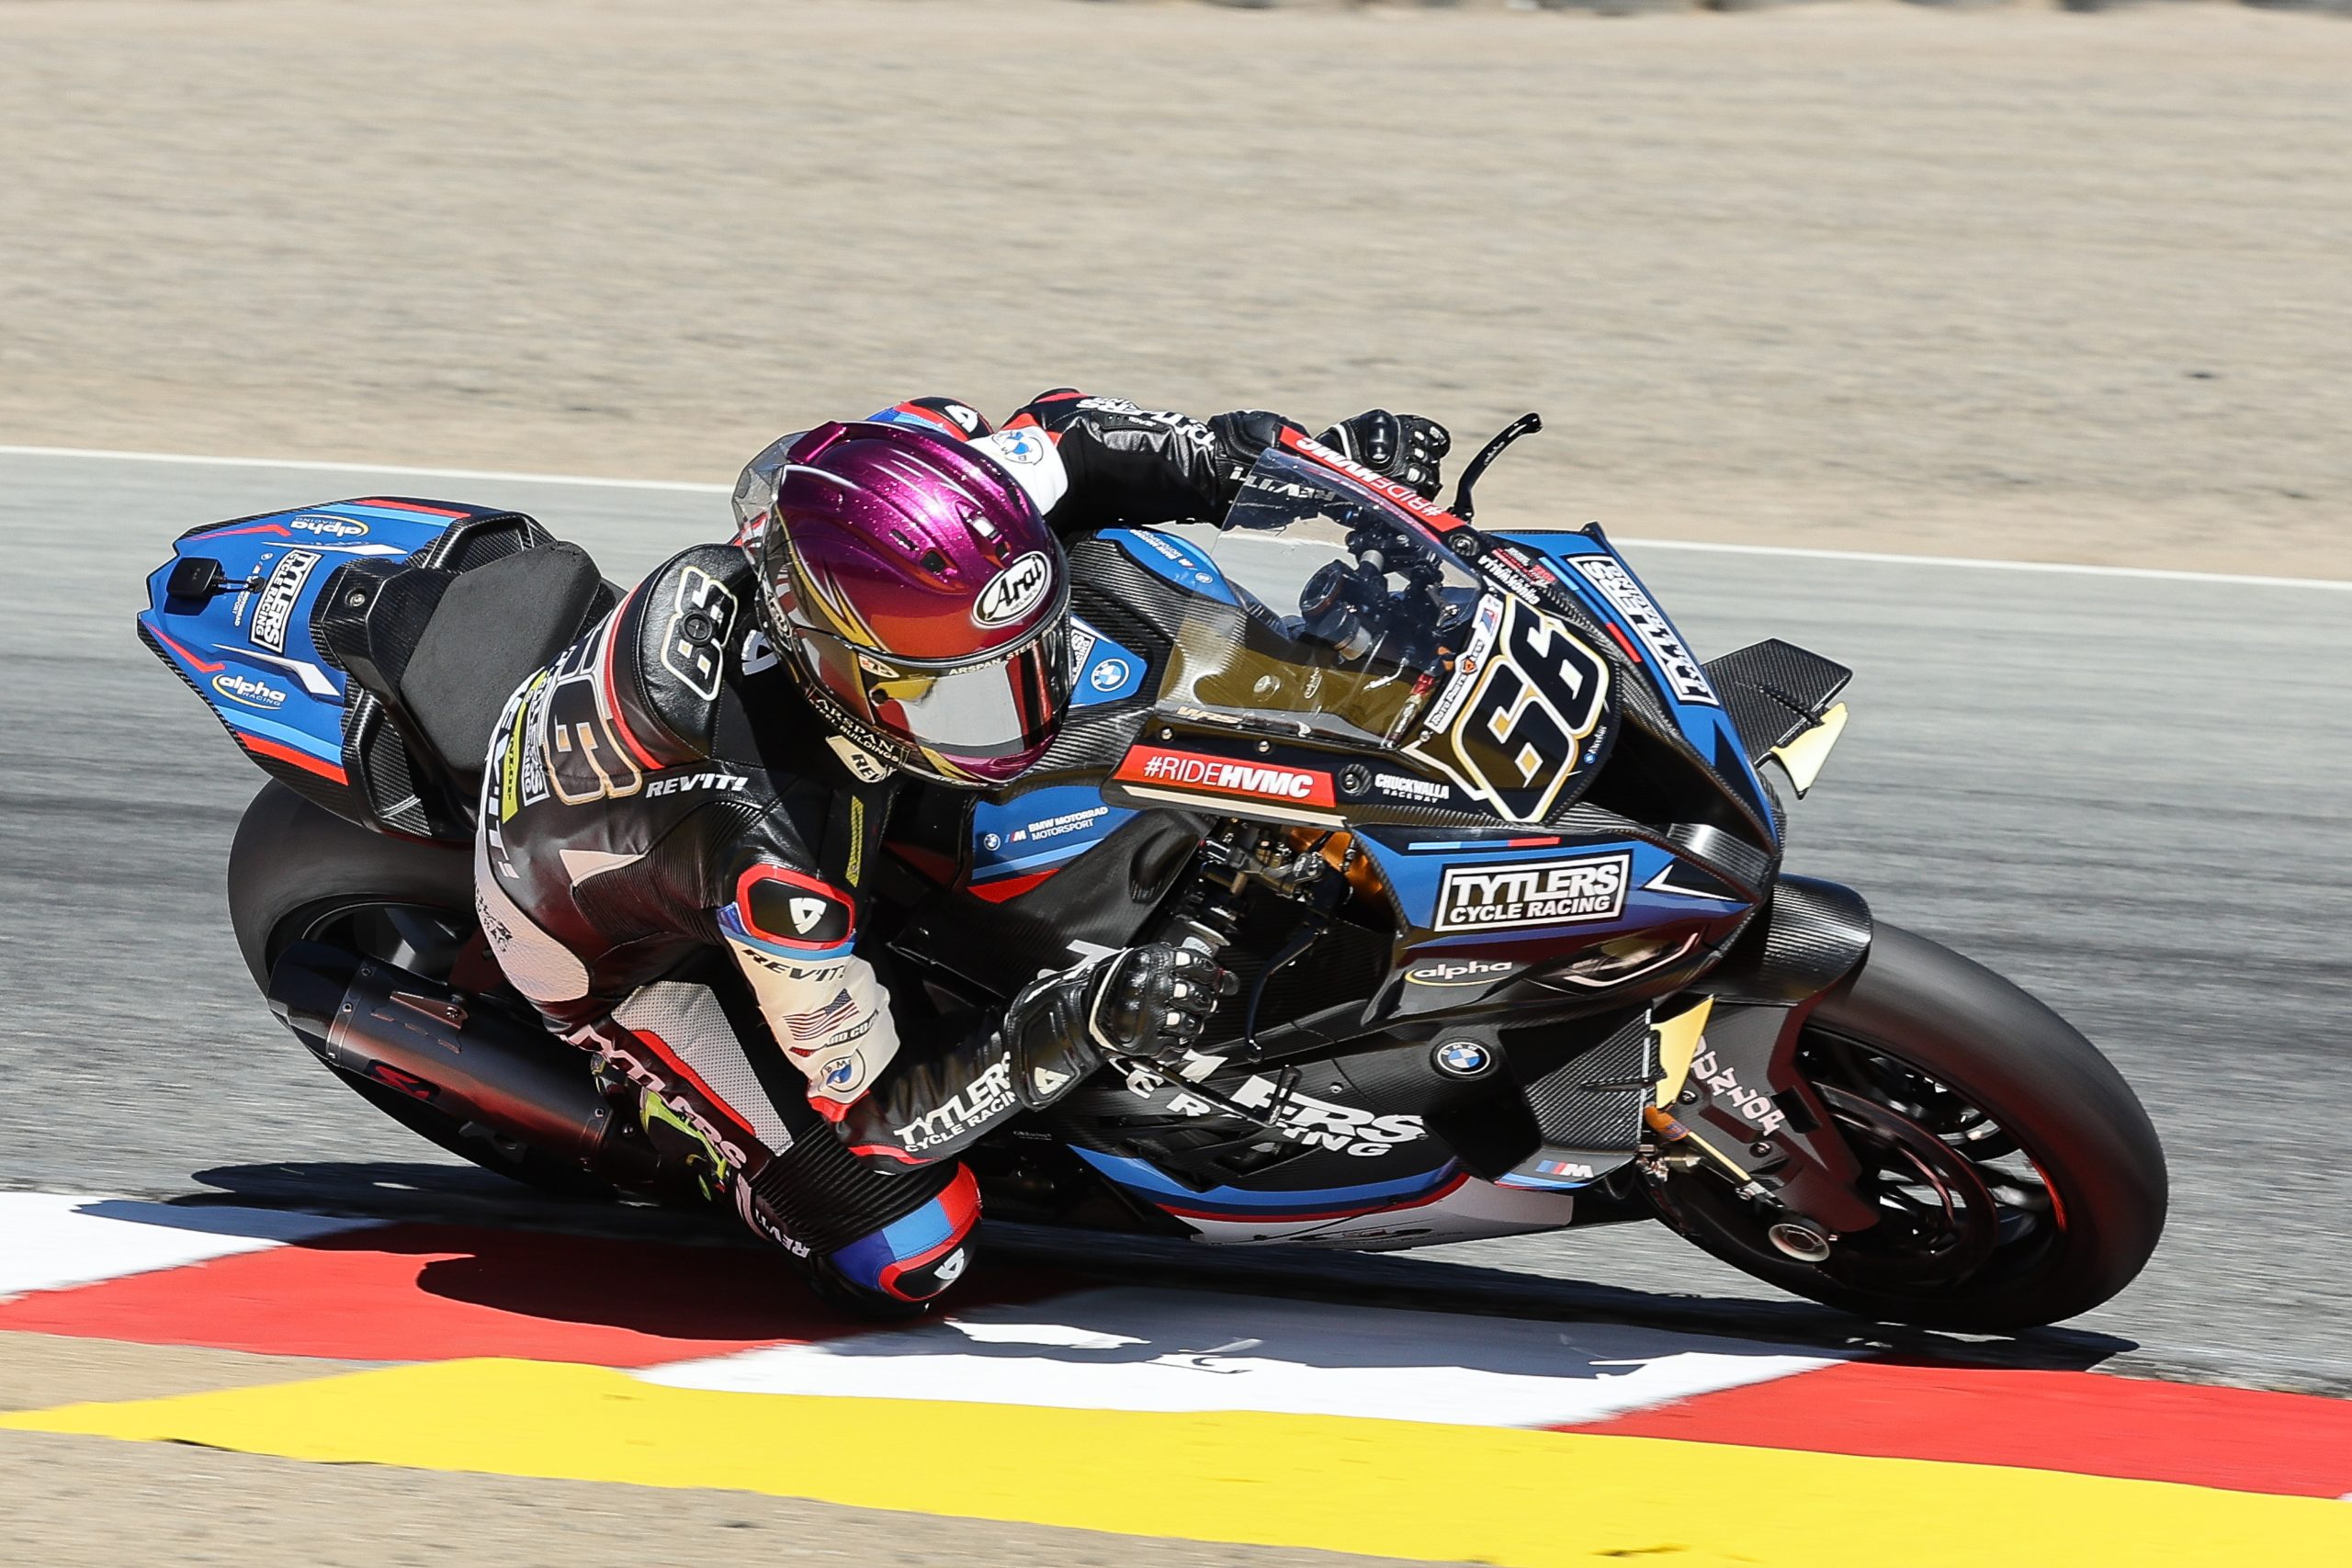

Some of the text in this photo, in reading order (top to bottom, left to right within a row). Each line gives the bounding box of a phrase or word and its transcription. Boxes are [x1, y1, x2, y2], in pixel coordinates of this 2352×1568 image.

[1295, 436, 1447, 517] #RIDEHVMC
[290, 521, 363, 537] alpha
[255, 553, 297, 637] CYCLE RACING
[263, 553, 312, 645] TYTLERS
[985, 554, 1042, 621] Arai
[948, 658, 1002, 676] ARSPAN
[219, 676, 287, 702] alpha
[243, 692, 281, 706] RACING
[1452, 593, 1610, 823] 66
[816, 699, 895, 752] ARSPAN
[838, 725, 900, 763] BUILDINGS
[645, 773, 749, 799] REV'IT!
[1144, 754, 1315, 798] #RIDEHVMC
[1374, 773, 1450, 800] CHUCKWALLA
[1382, 788, 1440, 804] RACEWAY
[1027, 818, 1055, 833] BMW
[1054, 806, 1109, 826] MOTORRAD
[1031, 818, 1094, 840] MOTORSPORT
[1451, 863, 1621, 905] TYTLERS
[1450, 895, 1611, 924] CYCLE RACING
[742, 948, 847, 983] REV'IT!
[1414, 961, 1513, 980] alpha
[905, 1090, 1016, 1154] CYCLE RACIN
